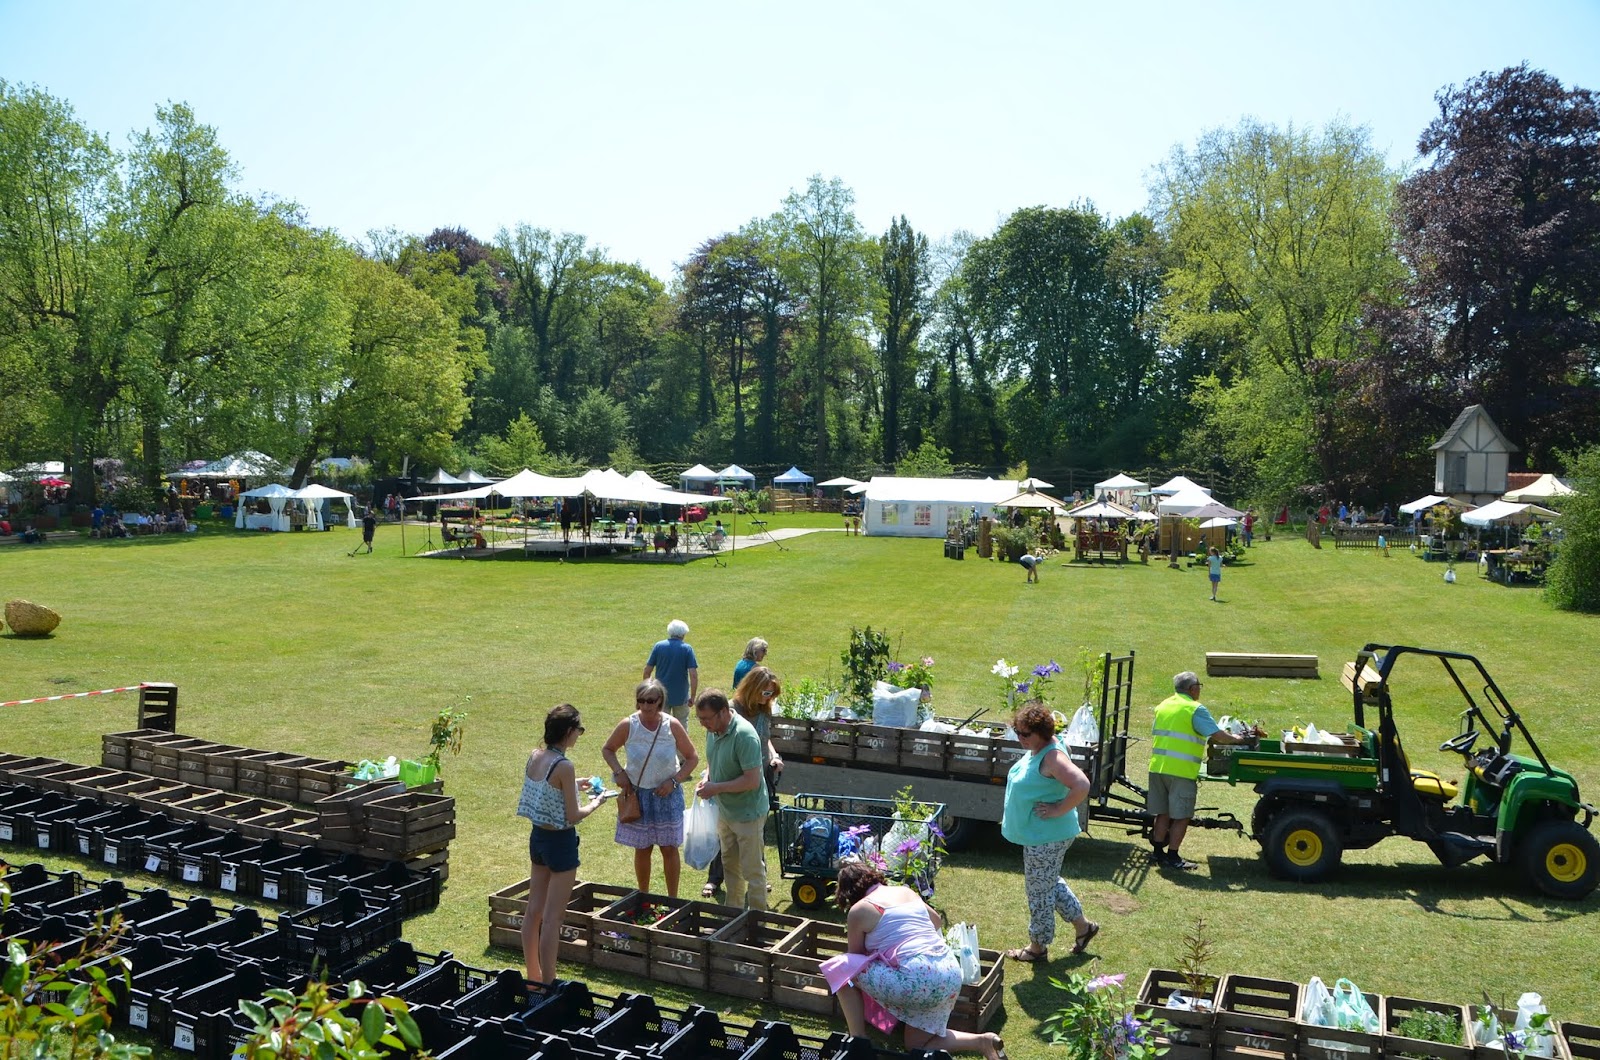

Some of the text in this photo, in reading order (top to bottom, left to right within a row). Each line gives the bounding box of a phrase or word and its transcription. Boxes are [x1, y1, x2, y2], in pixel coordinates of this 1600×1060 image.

[867, 738, 884, 748] 104
[913, 743, 929, 752] 101
[964, 748, 979, 757] 100
[1009, 752, 1022, 761] 99
[1221, 749, 1235, 757] 10
[279, 777, 288, 785] 76
[310, 782, 319, 790] 75
[560, 927, 580, 940] 159
[612, 939, 631, 951] 156
[670, 950, 693, 964] 153
[733, 963, 756, 975] 152
[794, 975, 814, 986] 151
[136, 1013, 145, 1021] 90
[181, 1035, 191, 1043] 89
[1244, 1036, 1270, 1050] 144
